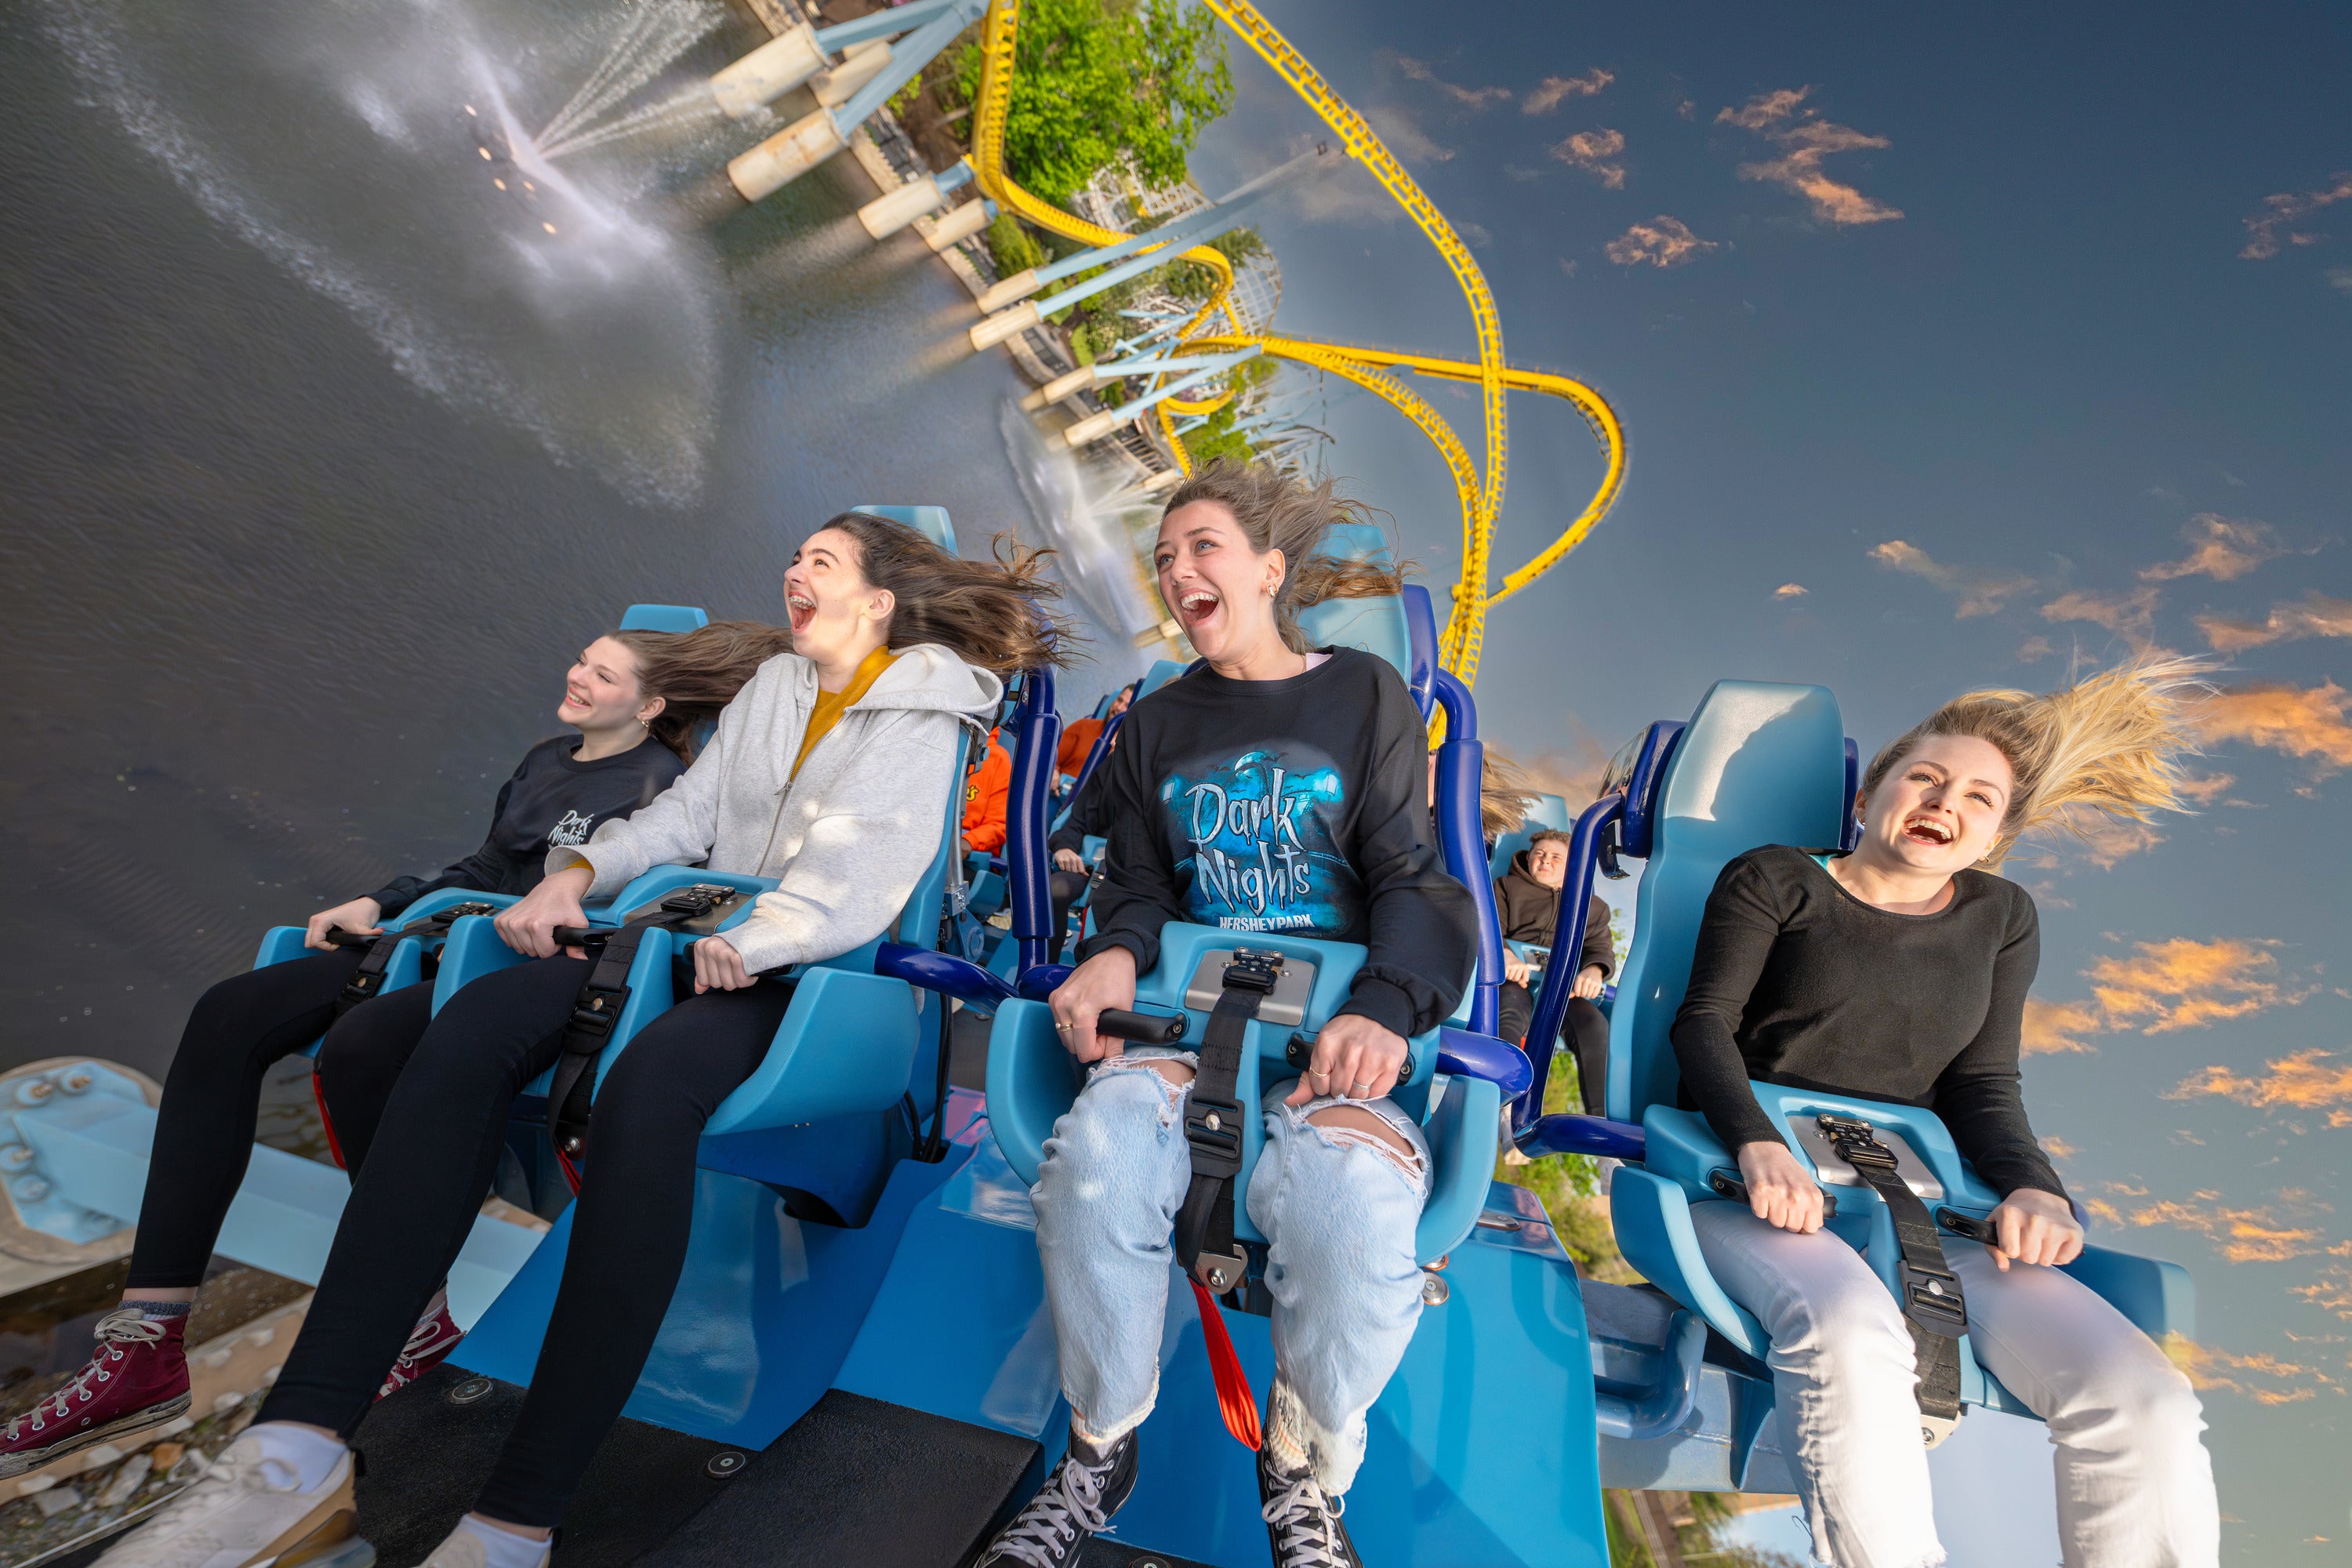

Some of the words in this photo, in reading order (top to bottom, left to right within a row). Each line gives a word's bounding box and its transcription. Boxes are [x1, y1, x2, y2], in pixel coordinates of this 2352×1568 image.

[557, 809, 595, 836] Dark
[1185, 768, 1308, 852] Dark
[547, 824, 585, 846] Nights
[1196, 840, 1310, 916] Nights
[1219, 913, 1316, 932] HERSHEYPARK
